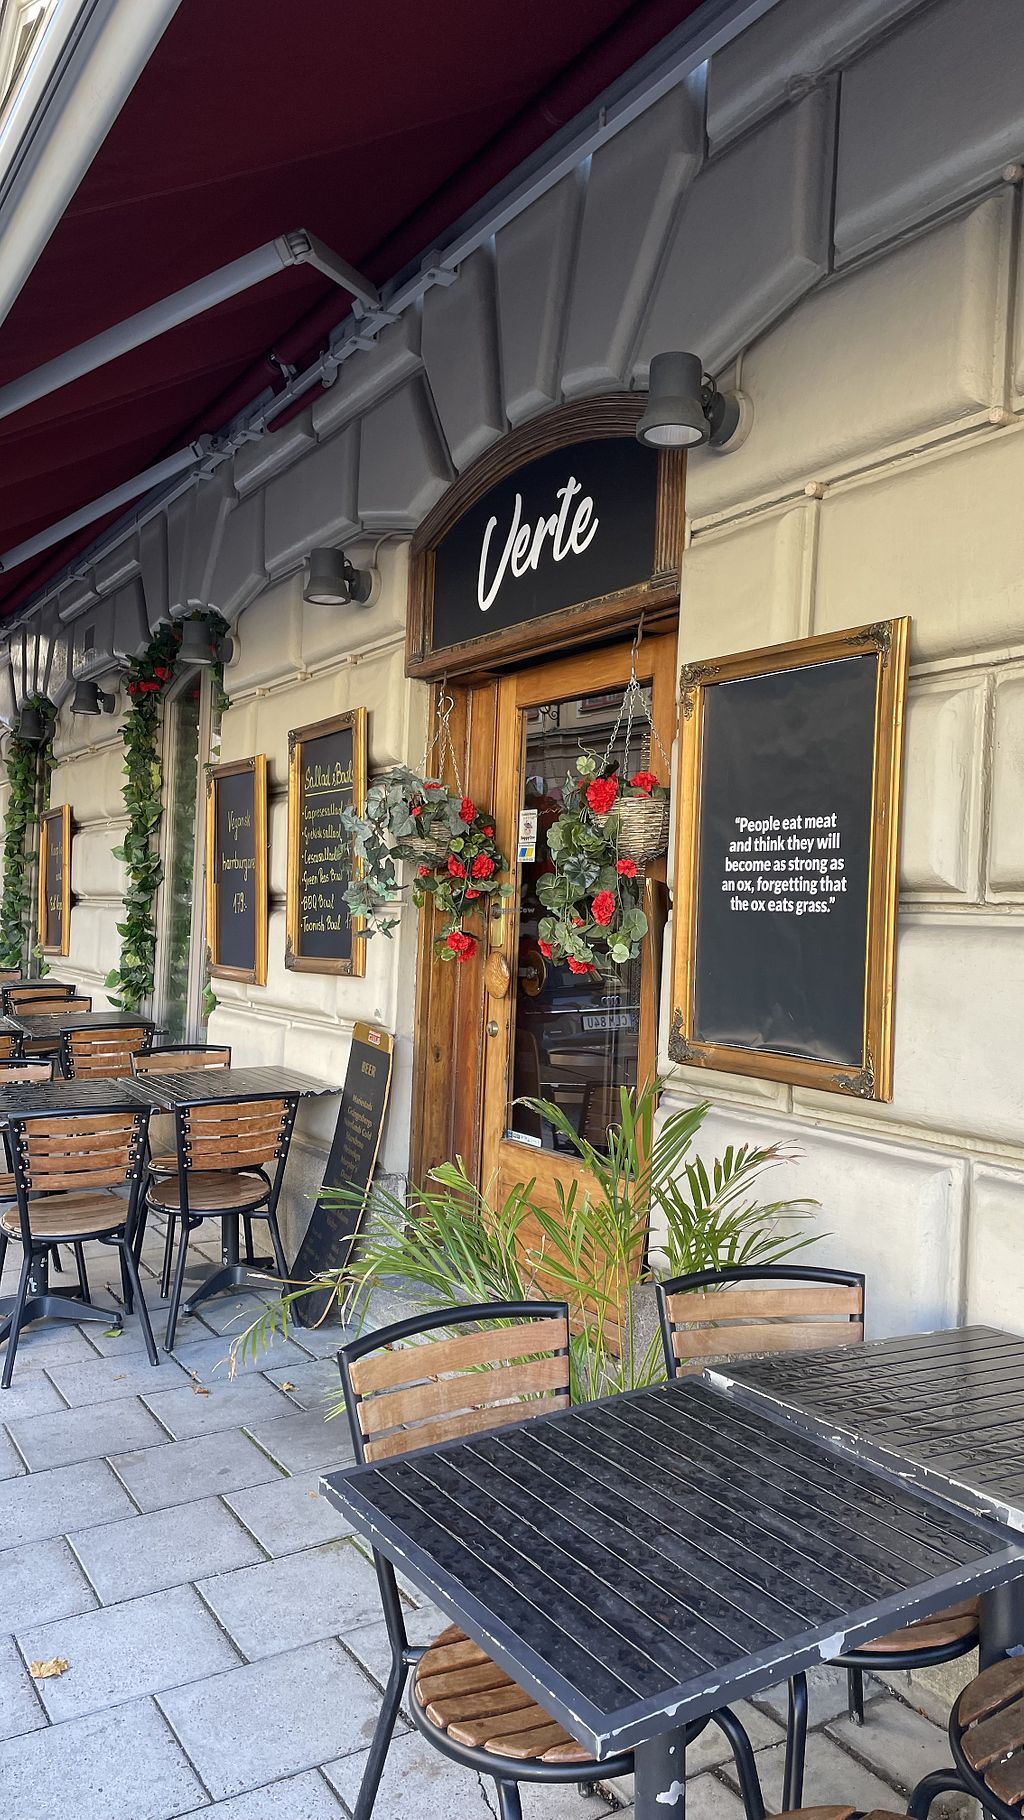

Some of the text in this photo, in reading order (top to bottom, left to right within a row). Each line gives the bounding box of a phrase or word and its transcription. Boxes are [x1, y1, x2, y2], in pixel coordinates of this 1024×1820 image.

[478, 476, 600, 612] Verte
[304, 764, 331, 790] Sallad
[782, 815, 802, 830] eat
[805, 813, 837, 828] meat
[729, 833, 840, 853] and think they will
[725, 857, 845, 873] become as strong as
[722, 876, 847, 894] an ox, forgetting that
[303, 894, 318, 911] BBQ
[730, 896, 749, 911] the
[750, 899, 766, 911] ox
[767, 897, 794, 912] eats
[361, 1061, 377, 1078] BEER
